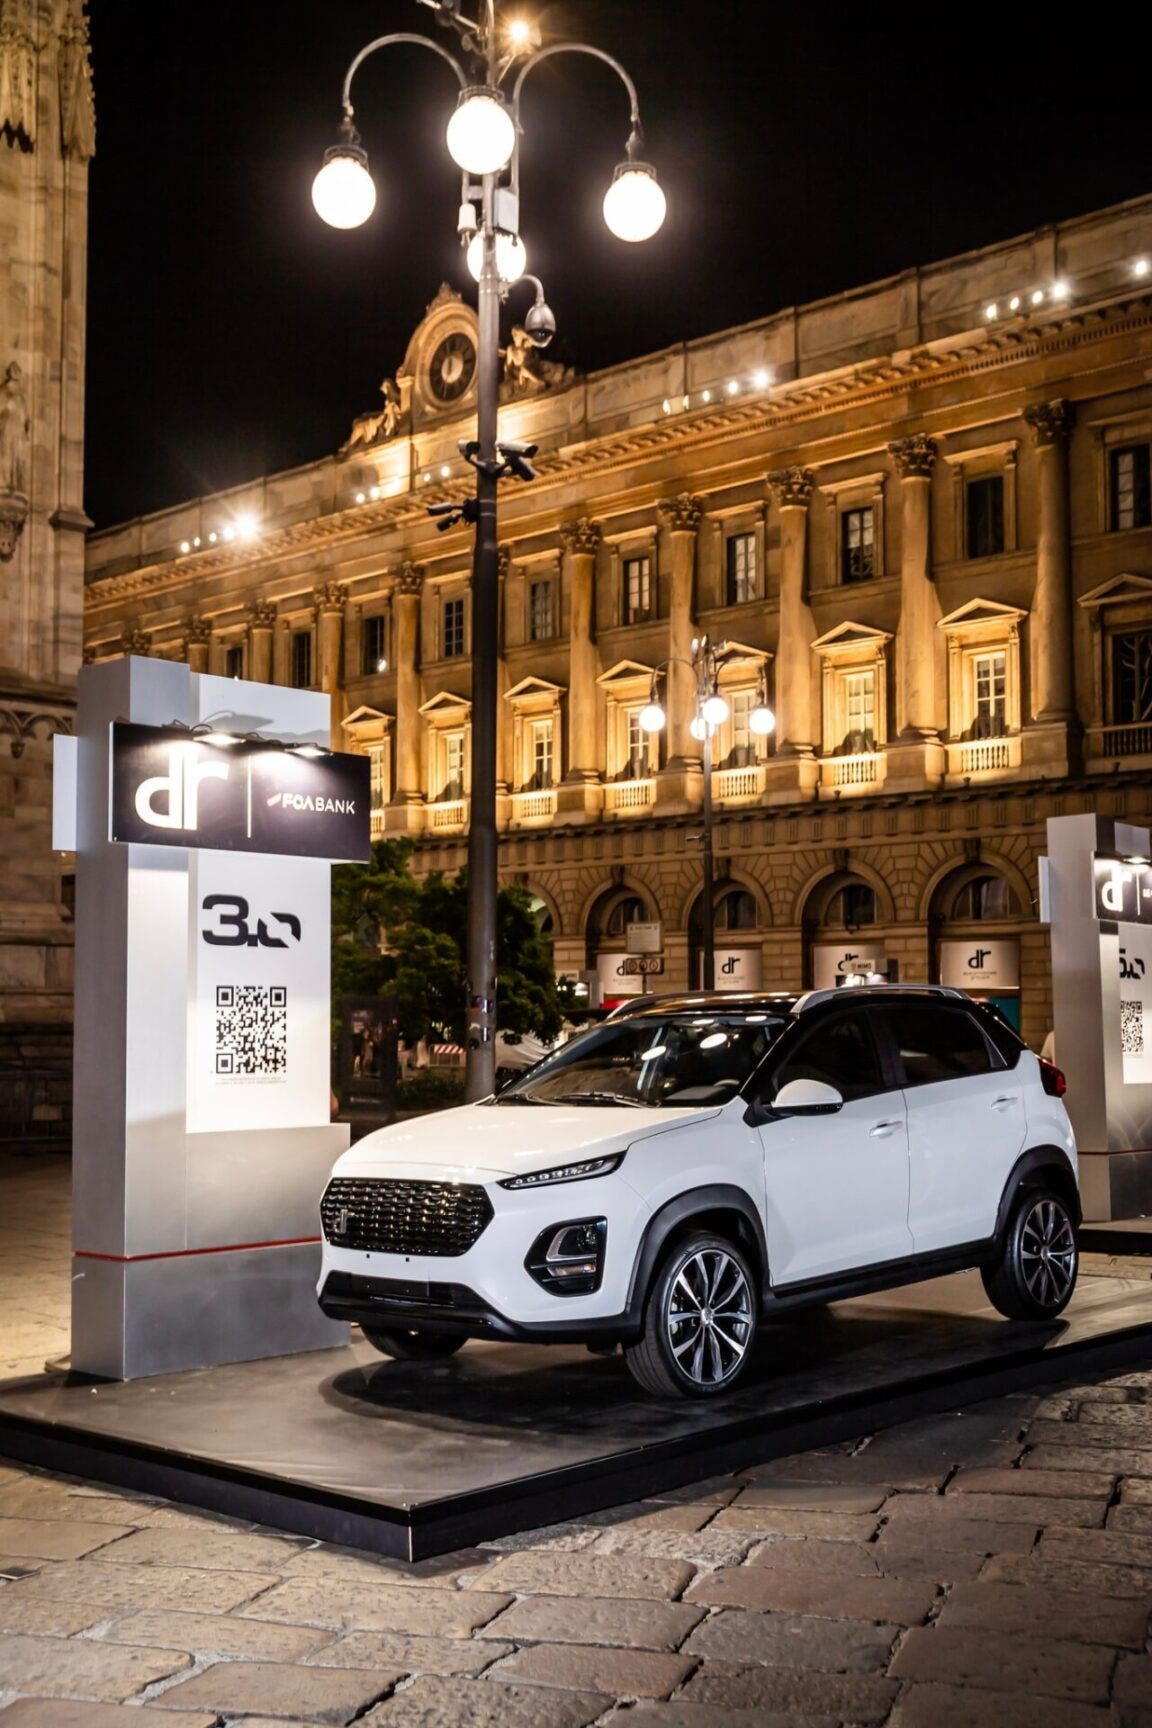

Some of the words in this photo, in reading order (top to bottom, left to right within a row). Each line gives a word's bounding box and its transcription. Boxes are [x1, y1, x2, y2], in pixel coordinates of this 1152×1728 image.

[135, 744, 230, 831] dr
[202, 893, 301, 949] 3.0
[721, 956, 741, 974] dr
[968, 949, 992, 969] dr
